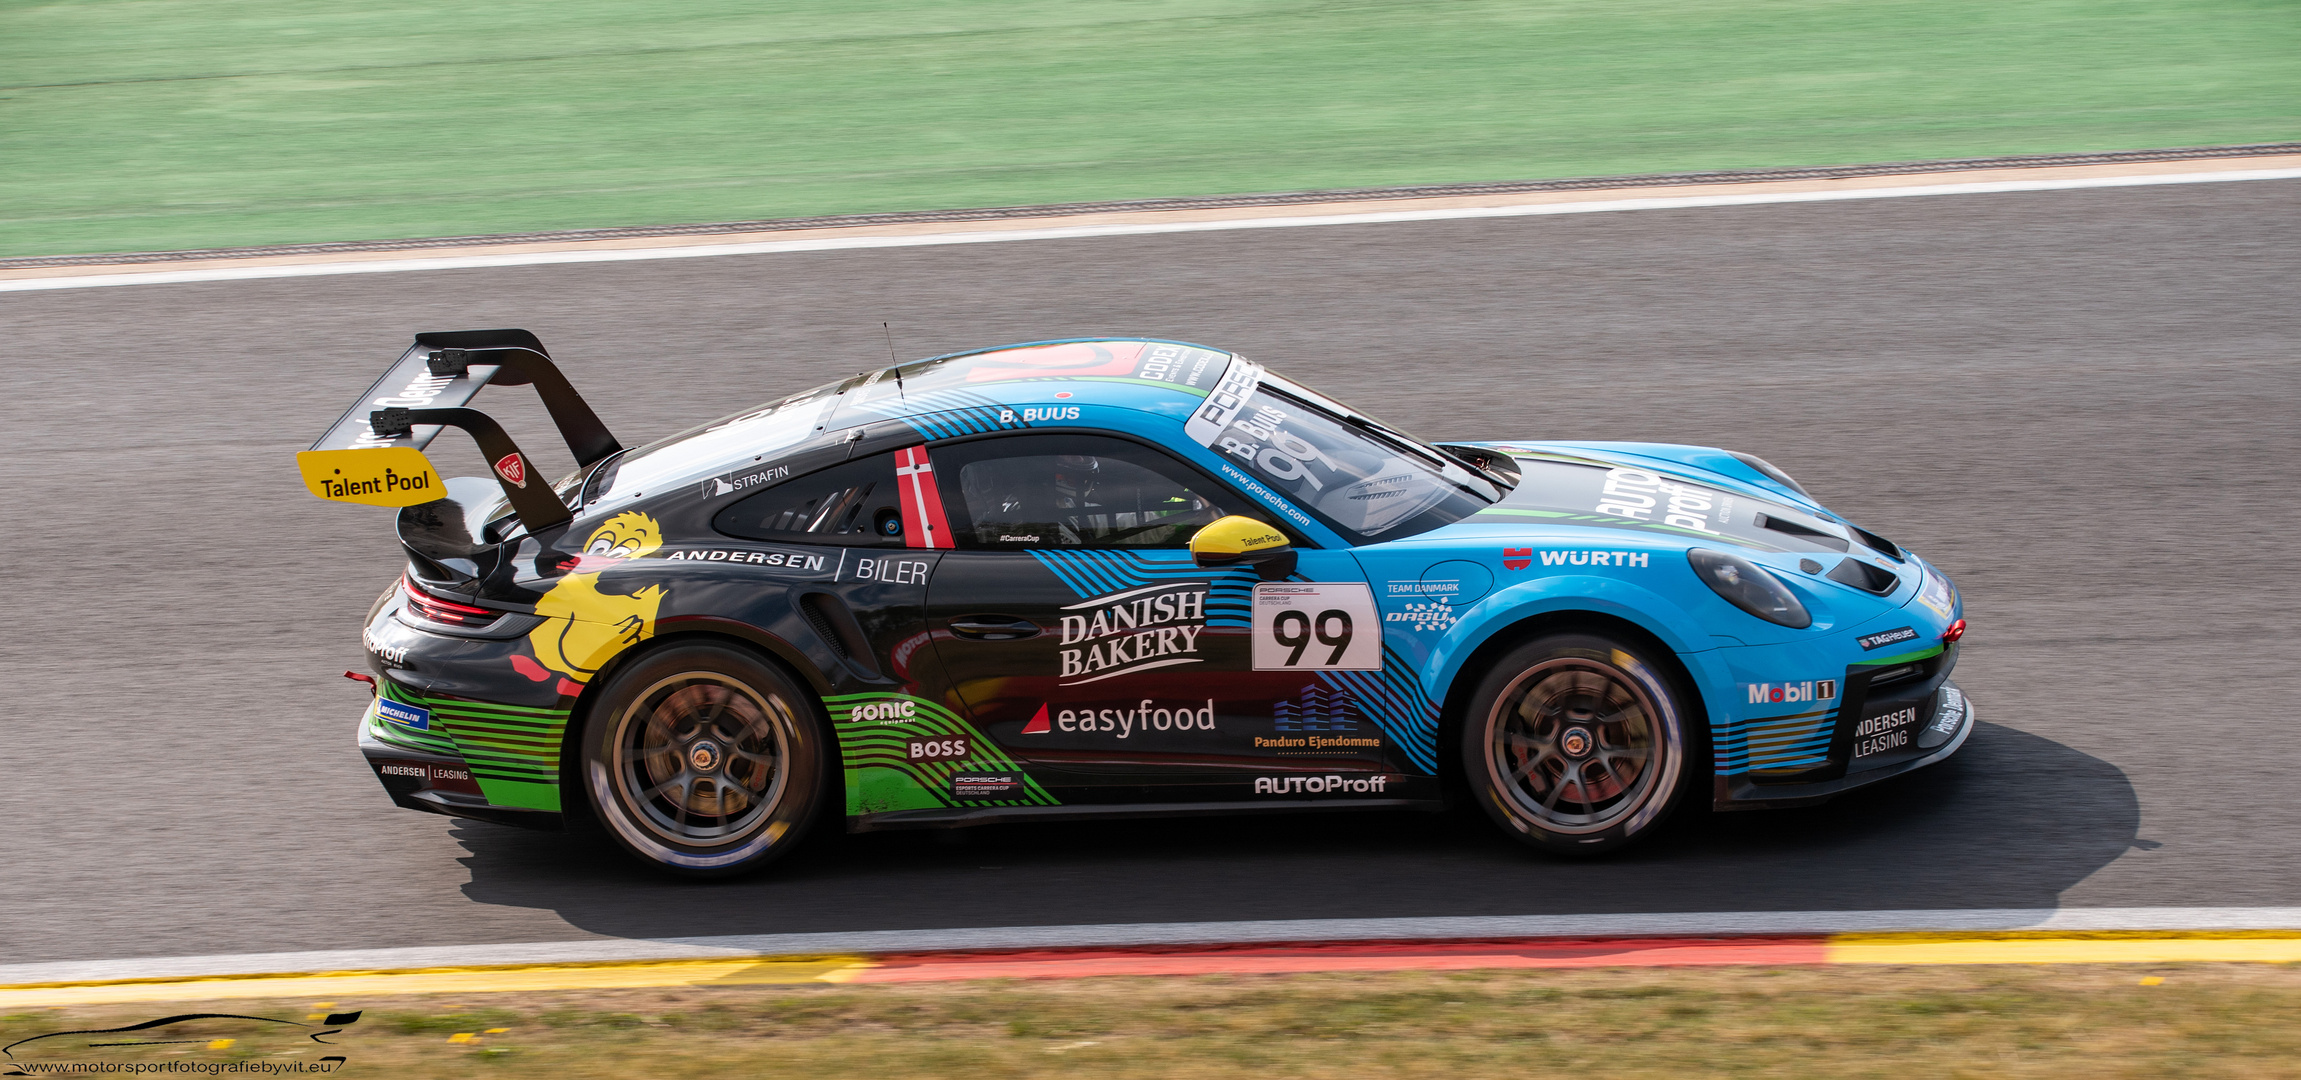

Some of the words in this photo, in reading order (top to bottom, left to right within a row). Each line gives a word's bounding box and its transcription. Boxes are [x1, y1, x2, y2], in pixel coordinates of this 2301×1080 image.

[1139, 346, 1181, 380] CODEX
[1000, 409, 1018, 424] B.
[1023, 407, 1080, 422] BUUS
[1218, 436, 1259, 461] B.
[503, 461, 520, 478] KIF
[1257, 434, 1337, 492] 99
[321, 476, 382, 499] Talent
[387, 471, 429, 492] Pool
[733, 465, 789, 490] STRAFIN
[1221, 463, 1310, 527] www.porsche.com
[1595, 467, 1662, 521] AUTO
[1000, 534, 1040, 544] #CarreraCup
[1241, 536, 1265, 548] Talent
[1266, 534, 1282, 544] Pool
[667, 550, 823, 572] ANDERSEN
[856, 558, 928, 586] BILER
[1540, 550, 1649, 568] WÜRTH
[1388, 584, 1412, 593] TEAM
[1414, 583, 1459, 592] DANMARK
[1059, 590, 1206, 646] DANISH
[1272, 608, 1353, 666] 99
[1059, 624, 1204, 677] BAKERY
[1749, 681, 1811, 704] Mobil
[381, 705, 420, 722] MICHELIN
[1058, 698, 1215, 738] easyfood
[1855, 707, 1916, 737] NDERSEN
[911, 739, 966, 758] BOSS
[1254, 736, 1305, 747] Panduro
[1309, 735, 1380, 749] Ejendomme
[1854, 730, 1908, 758] LEASING
[382, 765, 425, 777] ANDERSEN
[433, 767, 468, 780] LEASING
[1255, 775, 1386, 794] AUTOProff
